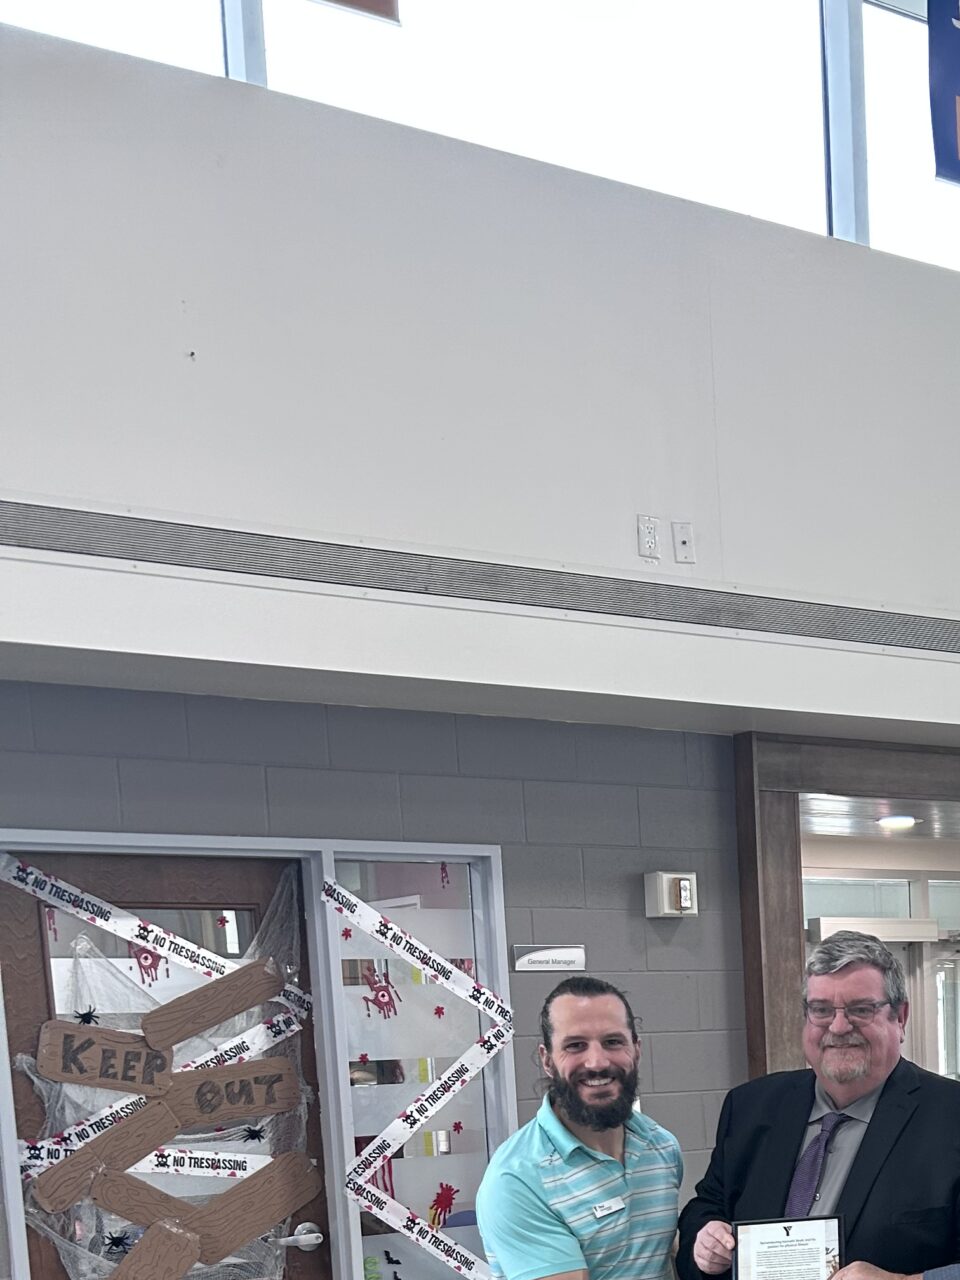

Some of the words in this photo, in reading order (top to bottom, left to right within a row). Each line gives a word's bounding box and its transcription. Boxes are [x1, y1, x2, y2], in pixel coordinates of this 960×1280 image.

[31, 875, 47, 891] NO
[48, 882, 112, 923] TRESPASSING
[321, 881, 358, 914] SPASSING
[152, 932, 166, 949] NO
[167, 940, 227, 976] TRESPASSING
[390, 931, 405, 946] NO
[403, 939, 453, 981] TRESPASSING
[483, 996, 495, 1010] NO
[492, 1028, 505, 1042] NO
[61, 1033, 168, 1086] KEEP
[194, 1073, 284, 1114] OUT
[416, 1103, 429, 1118] NO
[424, 1063, 470, 1108] TRESPASSING
[74, 1128, 90, 1142] NO
[88, 1097, 148, 1135] TRESPASSING
[47, 1148, 60, 1160] NO
[172, 1155, 189, 1168] NO
[189, 1156, 248, 1172] TRESPASSING
[345, 1179, 387, 1211] ESPASSING
[416, 1226, 429, 1241] NO
[428, 1233, 475, 1272] TRESPASSING
